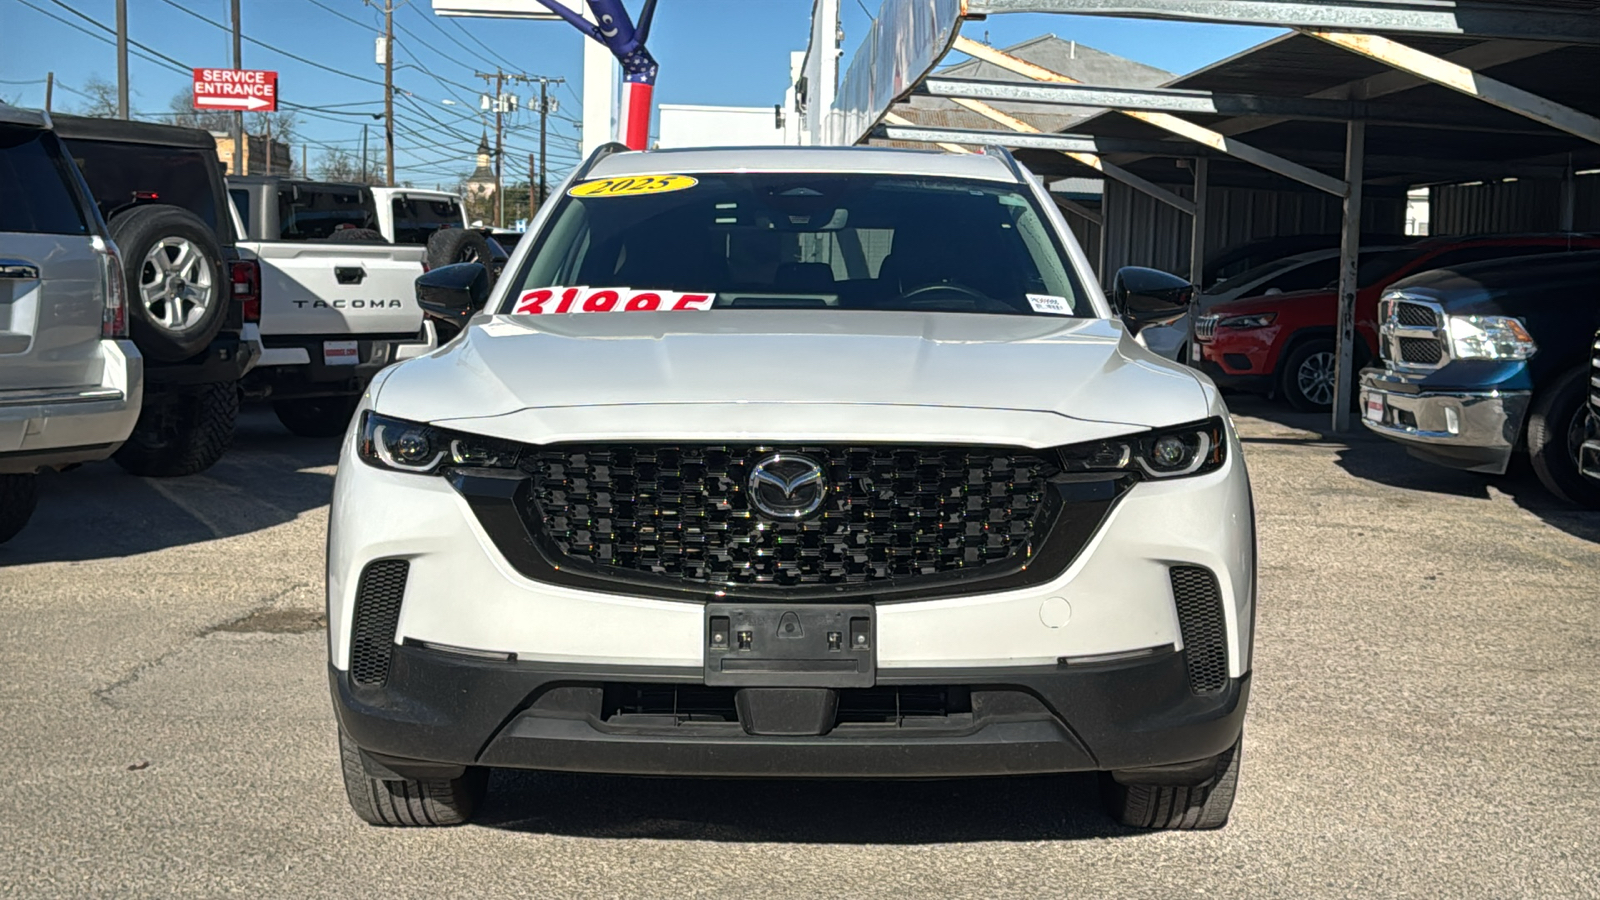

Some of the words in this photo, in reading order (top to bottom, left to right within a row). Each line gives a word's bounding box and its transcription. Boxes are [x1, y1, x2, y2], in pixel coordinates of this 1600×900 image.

[202, 69, 265, 83] SERVICE
[194, 81, 274, 96] ENTRANCE
[585, 176, 678, 194] 2025
[292, 300, 402, 308] TACOMA
